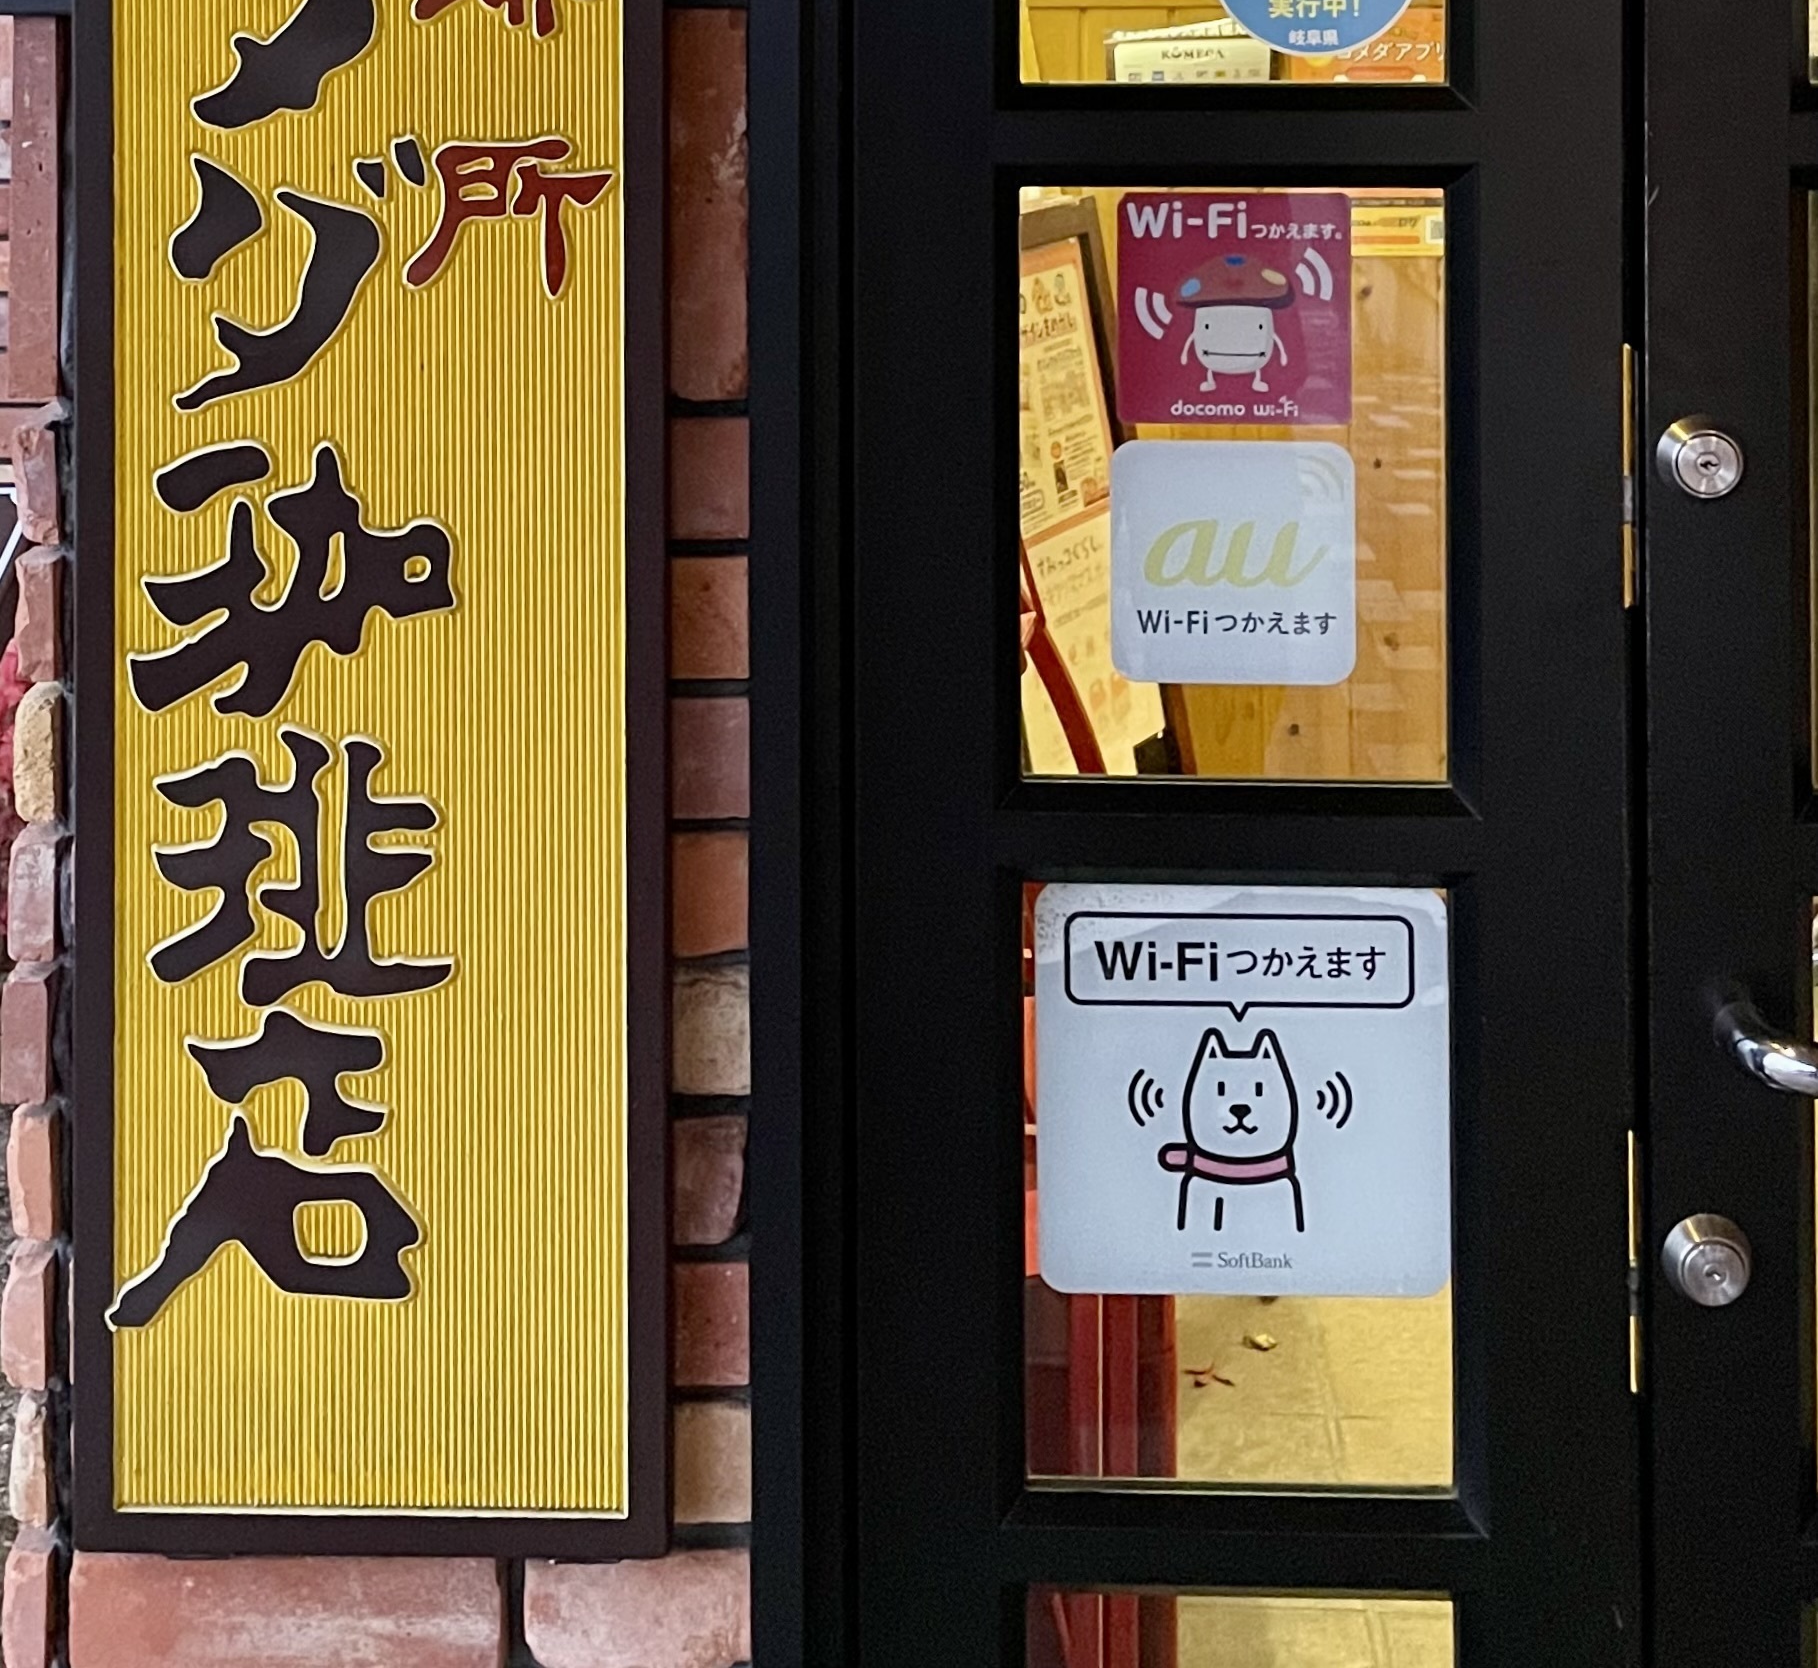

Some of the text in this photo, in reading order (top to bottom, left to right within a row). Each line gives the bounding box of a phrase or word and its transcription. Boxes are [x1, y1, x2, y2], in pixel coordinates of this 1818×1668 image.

[1288, 29, 1339, 47] 岐阜県
[1170, 400, 1246, 417] docomo
[1143, 519, 1328, 588] au
[1217, 1251, 1293, 1270] SoftBank
